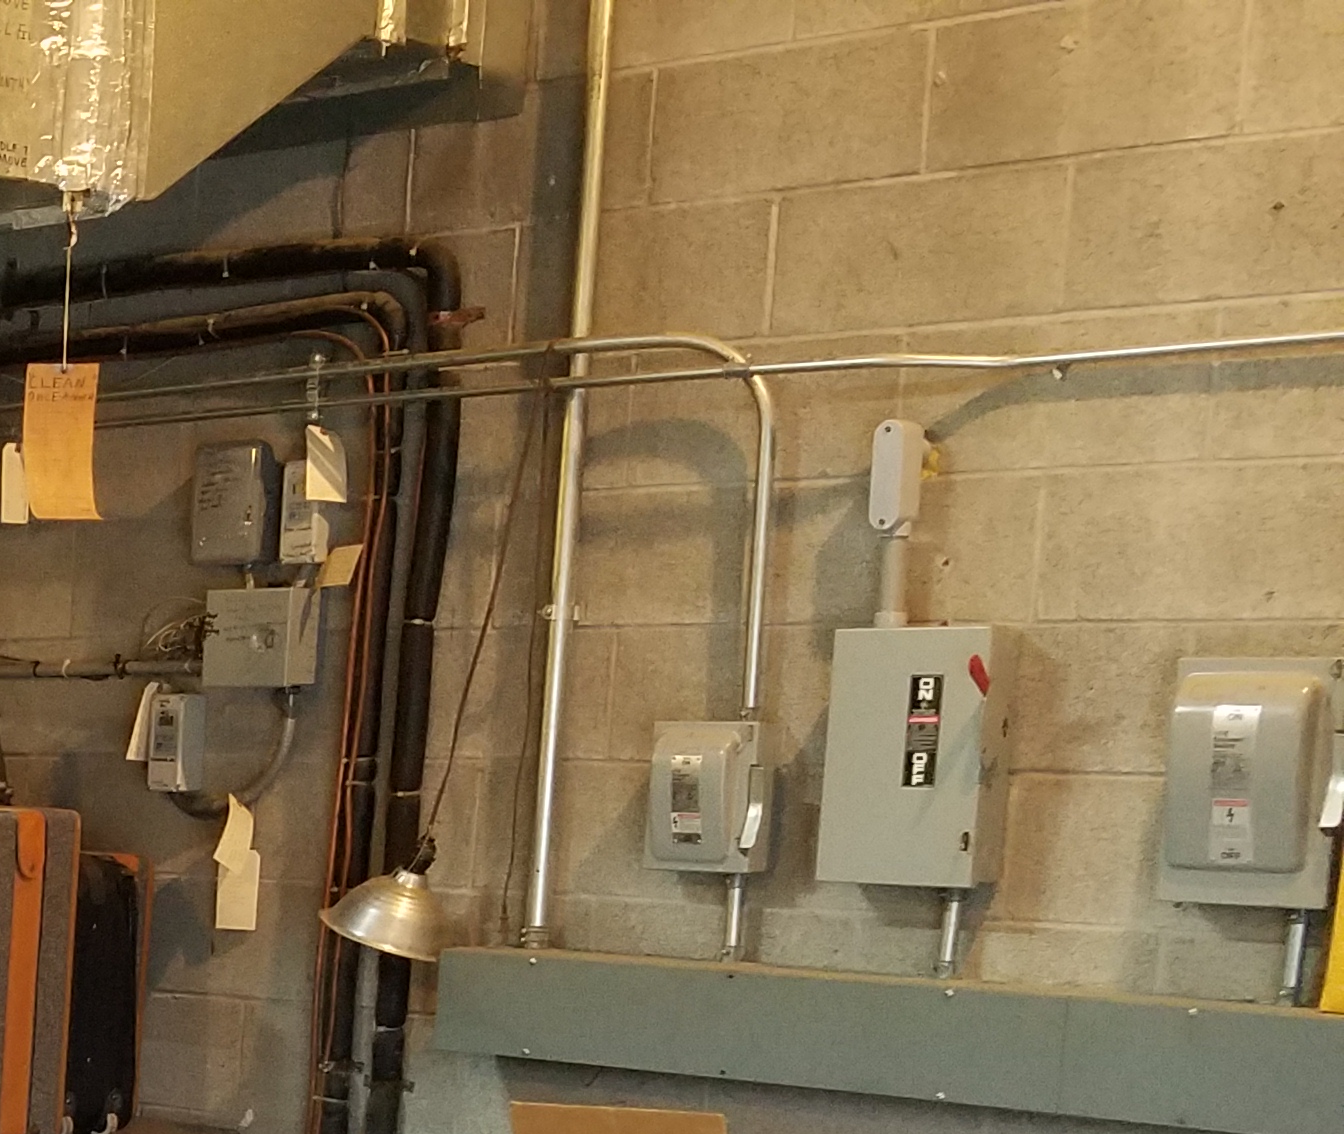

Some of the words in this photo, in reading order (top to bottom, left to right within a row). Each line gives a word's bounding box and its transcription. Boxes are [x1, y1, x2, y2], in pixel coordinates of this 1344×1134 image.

[28, 372, 87, 389] CLEAN
[917, 677, 935, 700] ON
[911, 752, 928, 786] OFF
